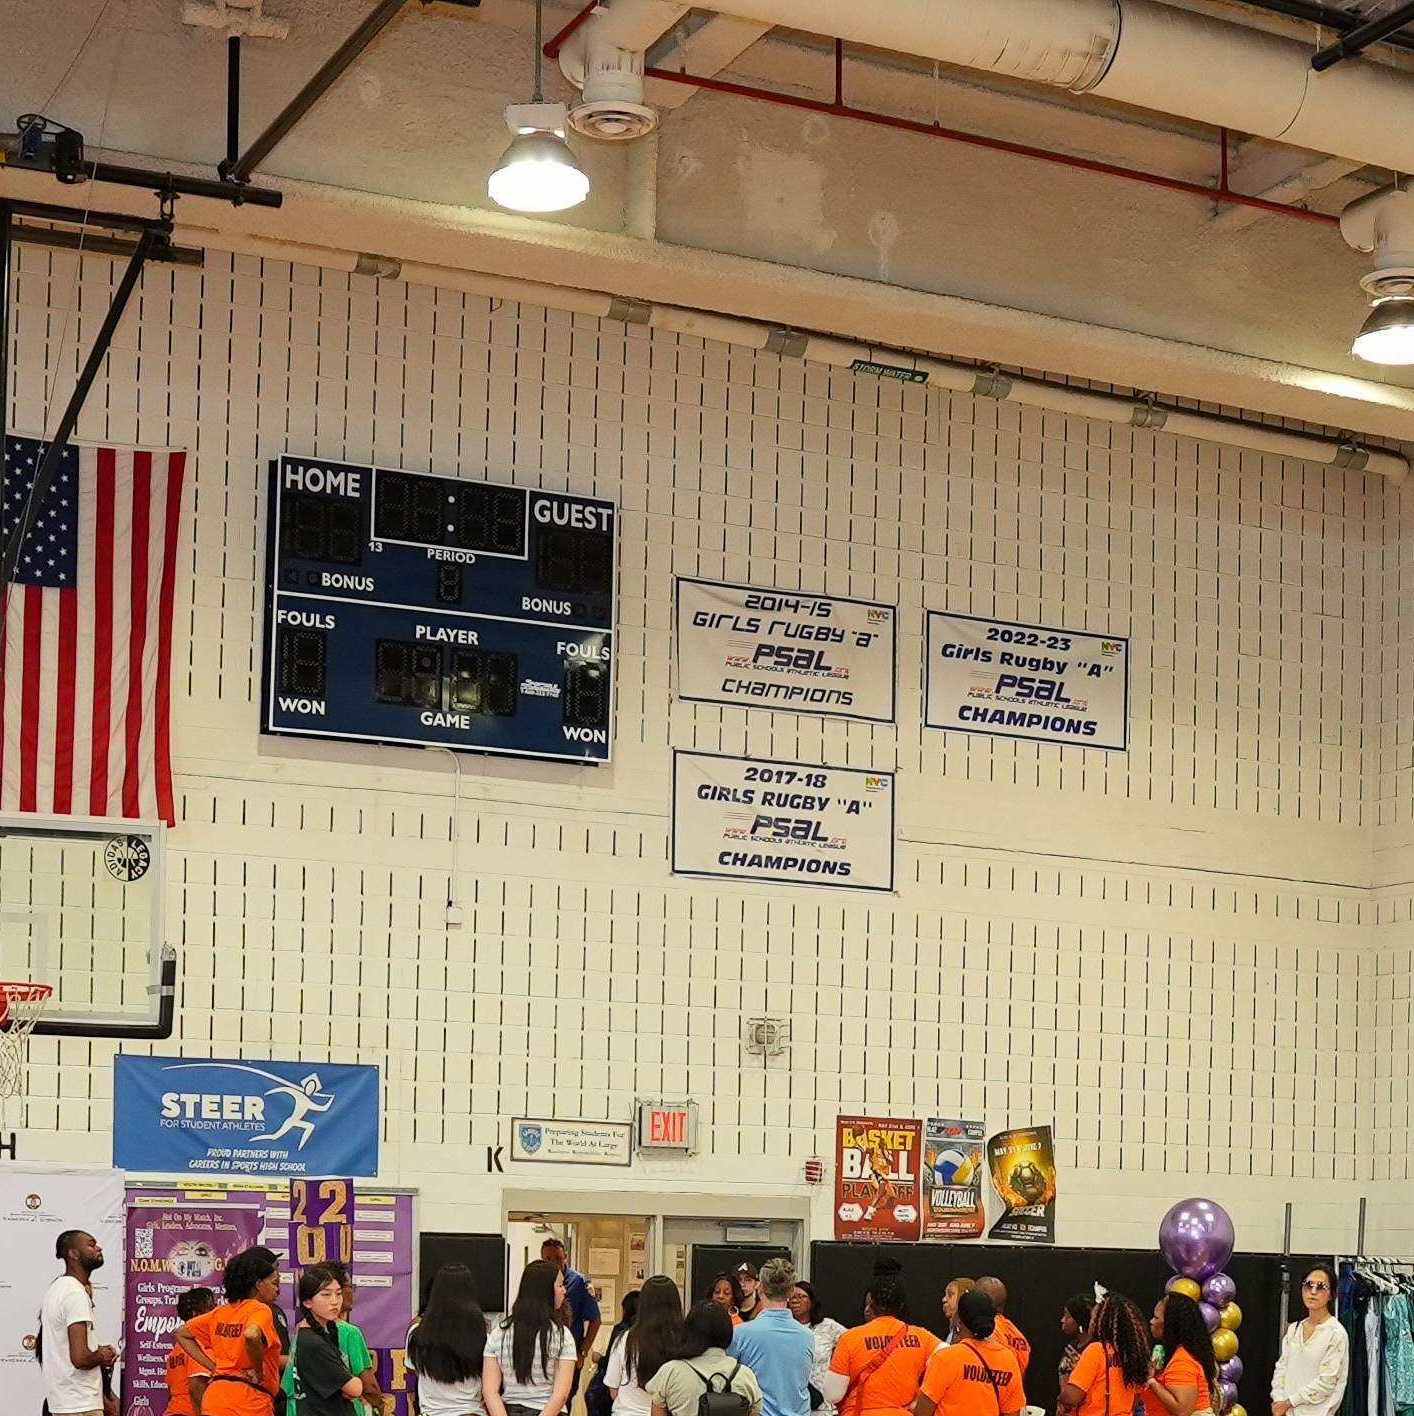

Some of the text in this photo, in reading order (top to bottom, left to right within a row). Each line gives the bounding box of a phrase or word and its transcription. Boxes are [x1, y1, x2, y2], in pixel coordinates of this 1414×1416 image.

[285, 464, 361, 498] HOME
[534, 499, 613, 532] GUEST
[368, 541, 383, 552] 13
[427, 549, 476, 565] PERIOD
[321, 572, 375, 592] BONUS
[522, 597, 571, 616] BONUS
[277, 609, 336, 630] FOULS
[415, 625, 479, 646] PLAYER
[986, 627, 1072, 651] 2022-23
[556, 641, 610, 661] FOULS
[941, 643, 993, 663] Girls
[1000, 651, 1068, 674] Rugby
[279, 697, 325, 716] WON
[421, 712, 470, 730] GAME
[958, 705, 1097, 736] CHAMPIONS
[562, 725, 606, 743] WON
[744, 767, 828, 788] 2017-18
[697, 784, 755, 805] GIRLS
[761, 791, 831, 811] RUGBY
[718, 851, 852, 876] CHAMPIONS
[160, 1092, 266, 1121] STEER
[160, 1119, 266, 1132] FOR STUDENT ATHLETES
[650, 1111, 687, 1142] EXIT
[487, 1146, 504, 1173] K
[292, 1180, 307, 1225] 2
[318, 1181, 347, 1225] 2
[931, 1189, 976, 1208] VOLLEYBALL
[137, 1282, 156, 1293] Girls
[864, 1335, 921, 1350] VOLTEER
